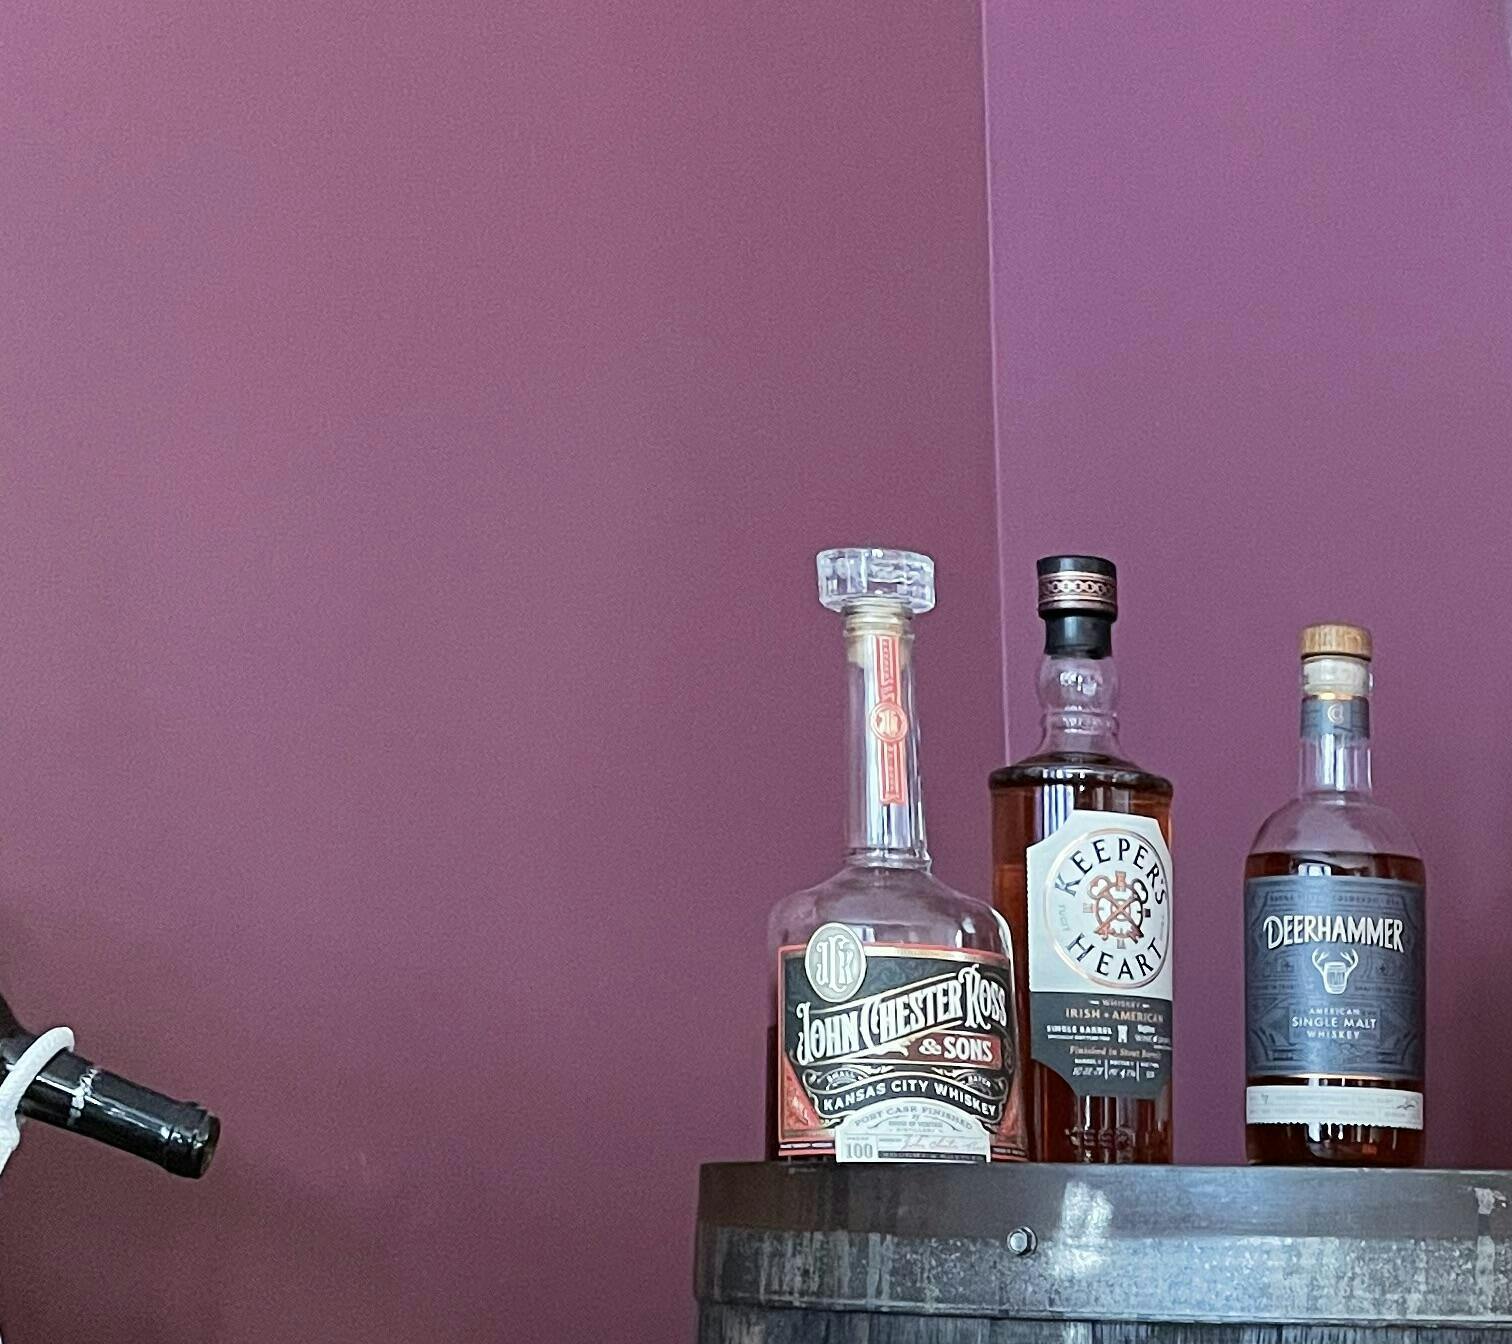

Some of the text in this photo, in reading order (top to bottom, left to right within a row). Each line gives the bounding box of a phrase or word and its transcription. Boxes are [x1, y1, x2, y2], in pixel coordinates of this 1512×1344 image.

[1055, 838, 1167, 905] KEEPER'S
[1262, 915, 1405, 953] DEERHAMMER
[1067, 932, 1162, 981] HEART
[796, 964, 1008, 1066] JOHN CHESTER ROSS
[1065, 1008, 1164, 1023] IRISH AMERICAN
[1291, 1016, 1377, 1030] SINGLE MALT
[943, 1036, 994, 1063] SONS
[1306, 1029, 1361, 1040] WHISKEY
[823, 1079, 998, 1117] KANSAS CITY WHISKEY
